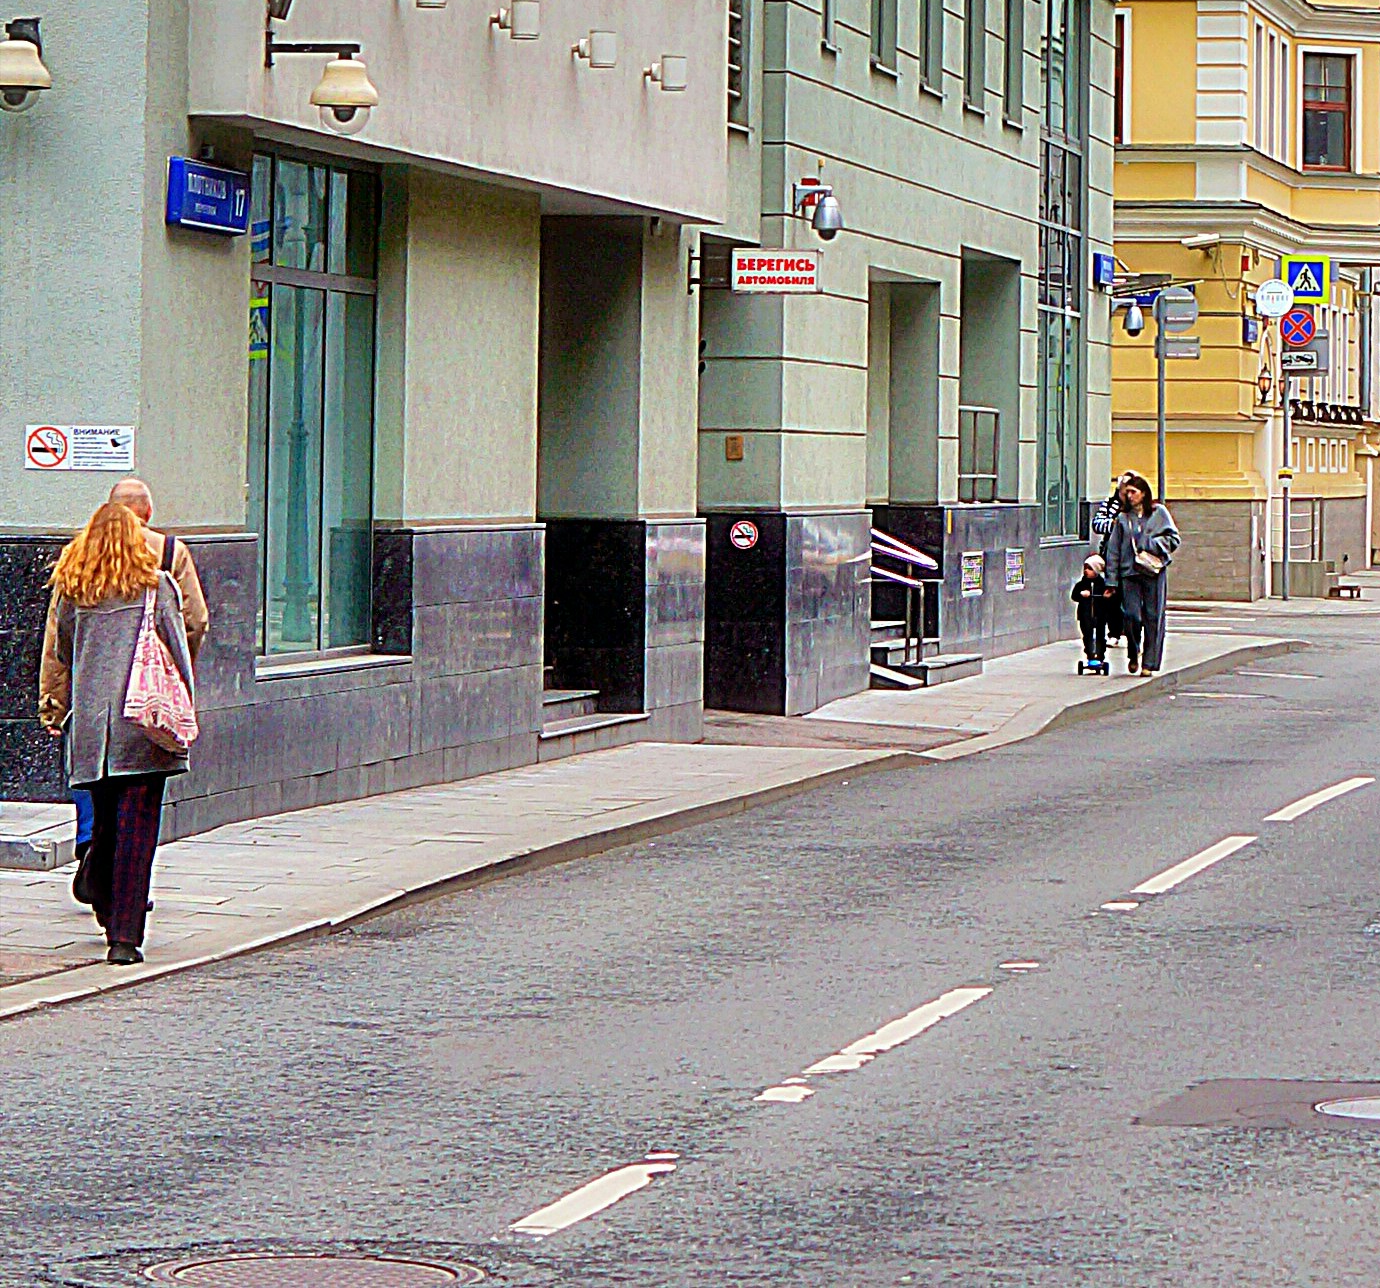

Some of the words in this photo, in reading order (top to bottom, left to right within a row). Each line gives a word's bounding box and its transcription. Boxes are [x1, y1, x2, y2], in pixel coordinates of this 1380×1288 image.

[235, 188, 246, 218] 17
[737, 258, 815, 272] БЕРЕГИСЬ
[737, 275, 815, 285] АВТОМОБИЛЯ
[73, 428, 121, 436] ВНИМАНИЕ
